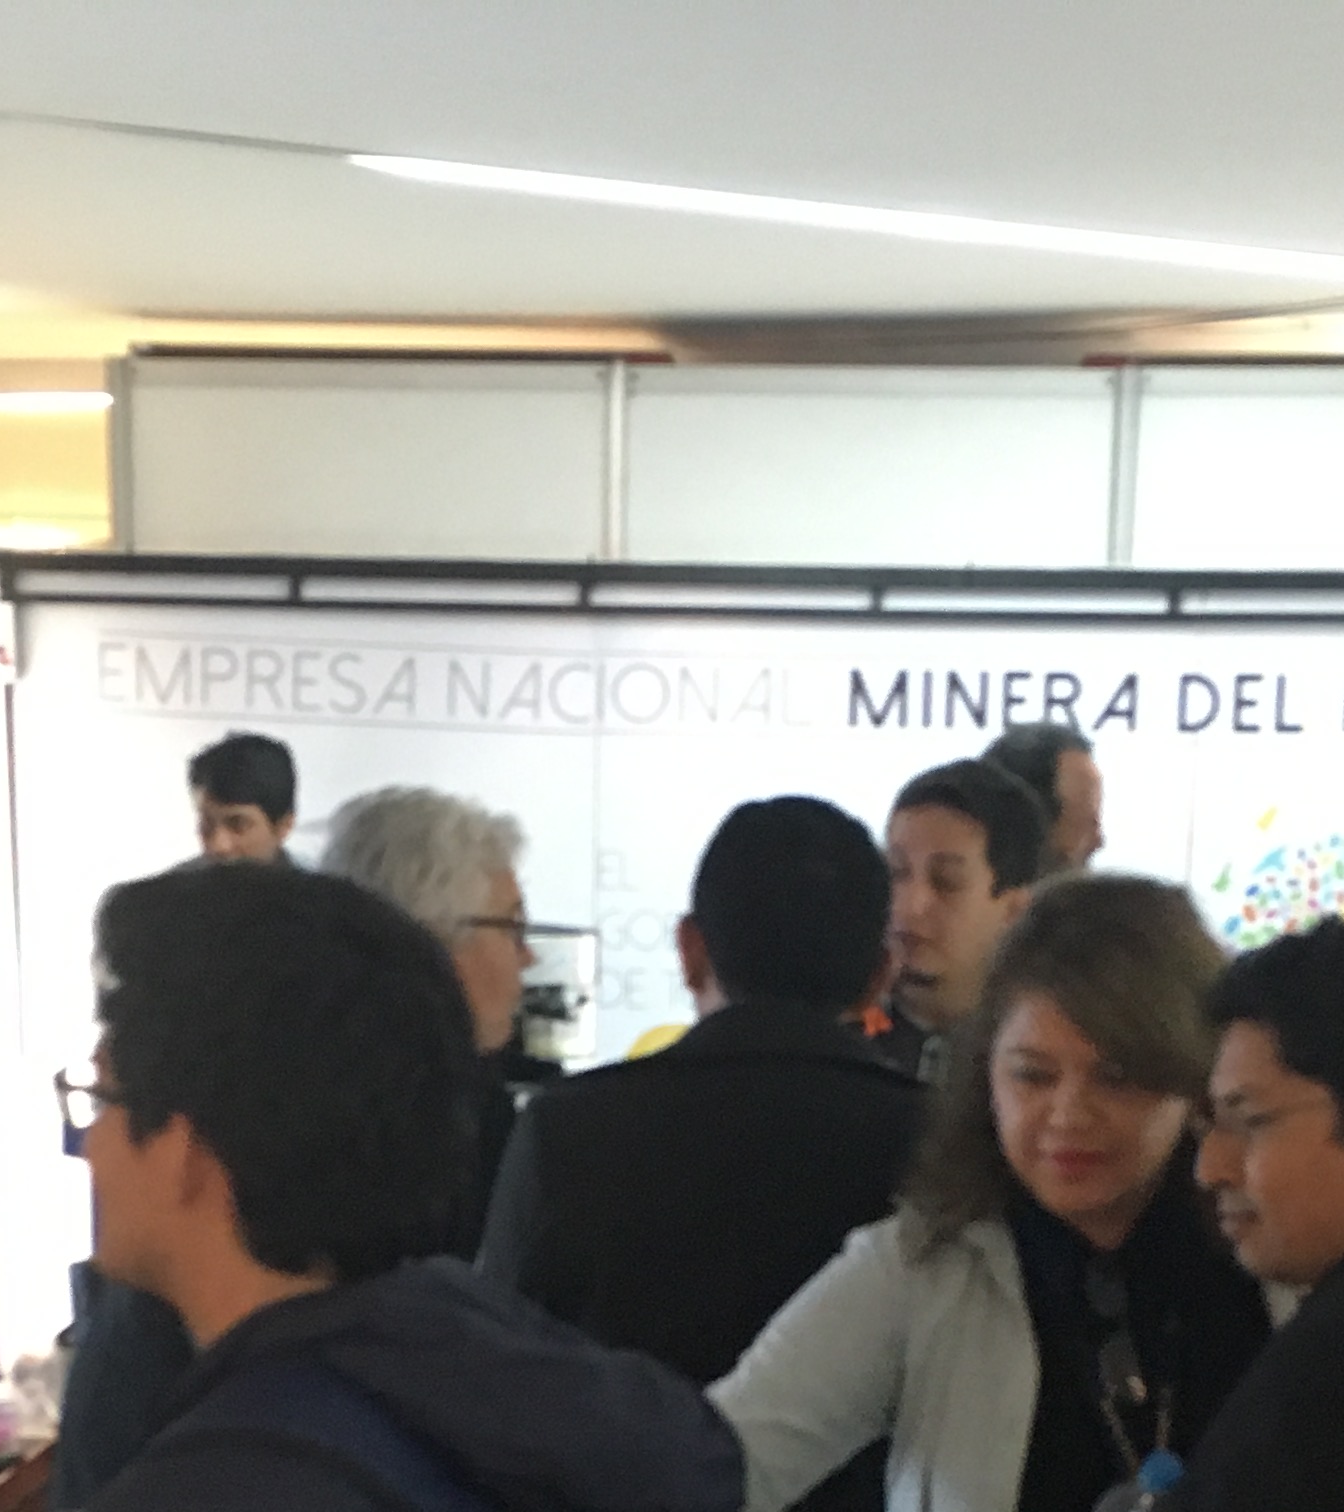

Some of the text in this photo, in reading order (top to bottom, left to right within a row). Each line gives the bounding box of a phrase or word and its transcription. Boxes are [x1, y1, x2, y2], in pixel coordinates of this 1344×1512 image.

[97, 641, 417, 717] EMPRESA
[445, 658, 812, 728] NACIONAL
[847, 668, 1139, 732] MINERA
[1177, 672, 1304, 733] DEL
